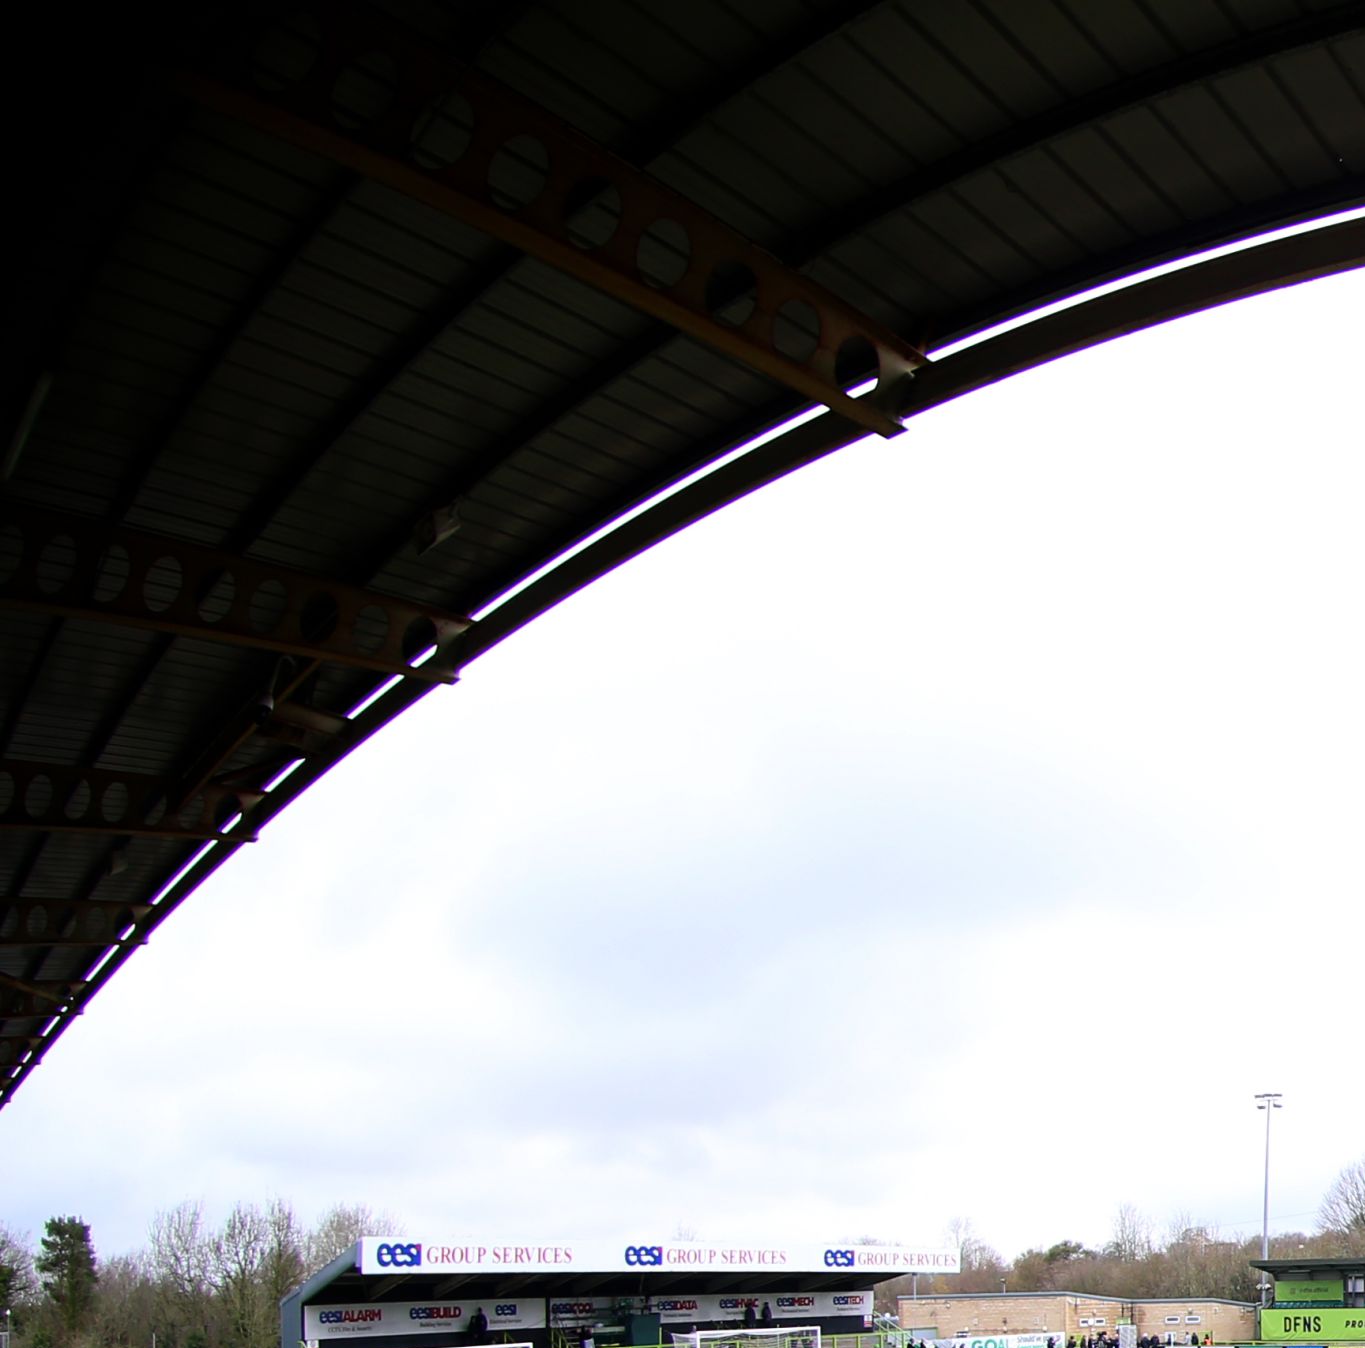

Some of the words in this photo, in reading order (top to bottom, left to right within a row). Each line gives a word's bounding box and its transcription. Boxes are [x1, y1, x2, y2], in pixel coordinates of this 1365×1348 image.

[427, 1246, 487, 1264] GROUP
[492, 1247, 572, 1264] SERVICES
[667, 1248, 717, 1265] GROUP
[721, 1249, 787, 1265] SERVICES
[858, 1251, 900, 1266] GROUP
[902, 1252, 957, 1267] SERVICES
[1283, 1316, 1322, 1333] DFNS
